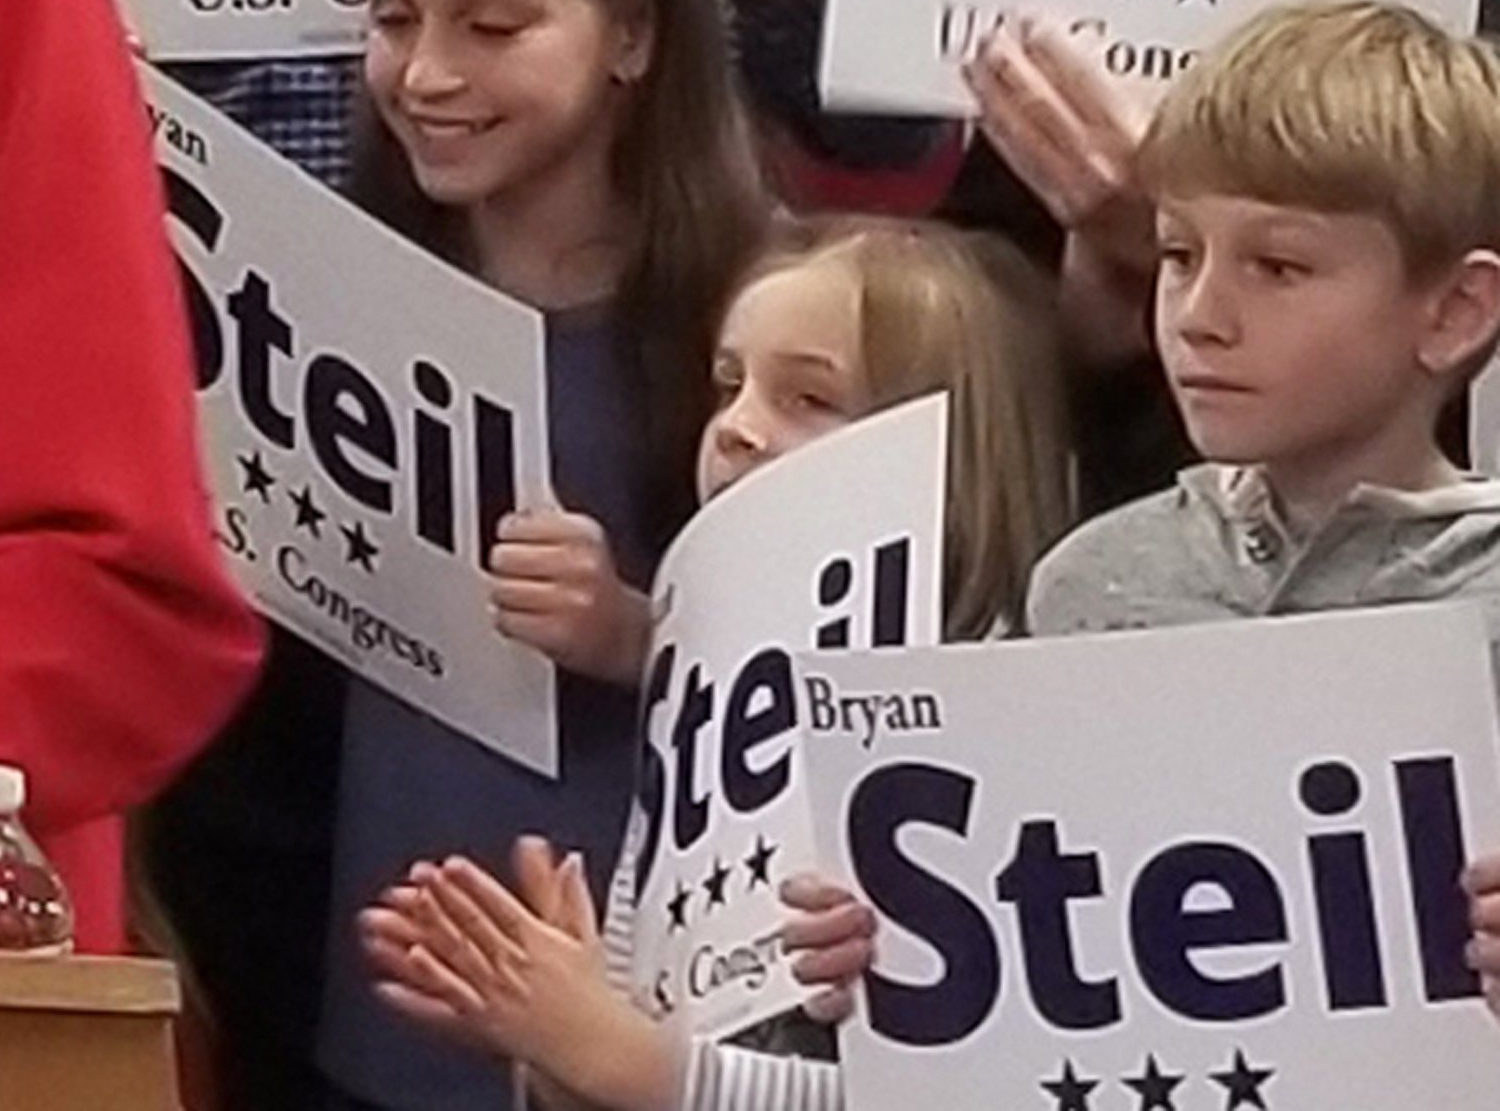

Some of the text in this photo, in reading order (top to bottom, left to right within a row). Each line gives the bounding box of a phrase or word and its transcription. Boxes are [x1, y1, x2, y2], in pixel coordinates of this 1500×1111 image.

[276, 545, 443, 677] Congress
[804, 676, 942, 750] Bryan
[847, 755, 1485, 1048] Steil
